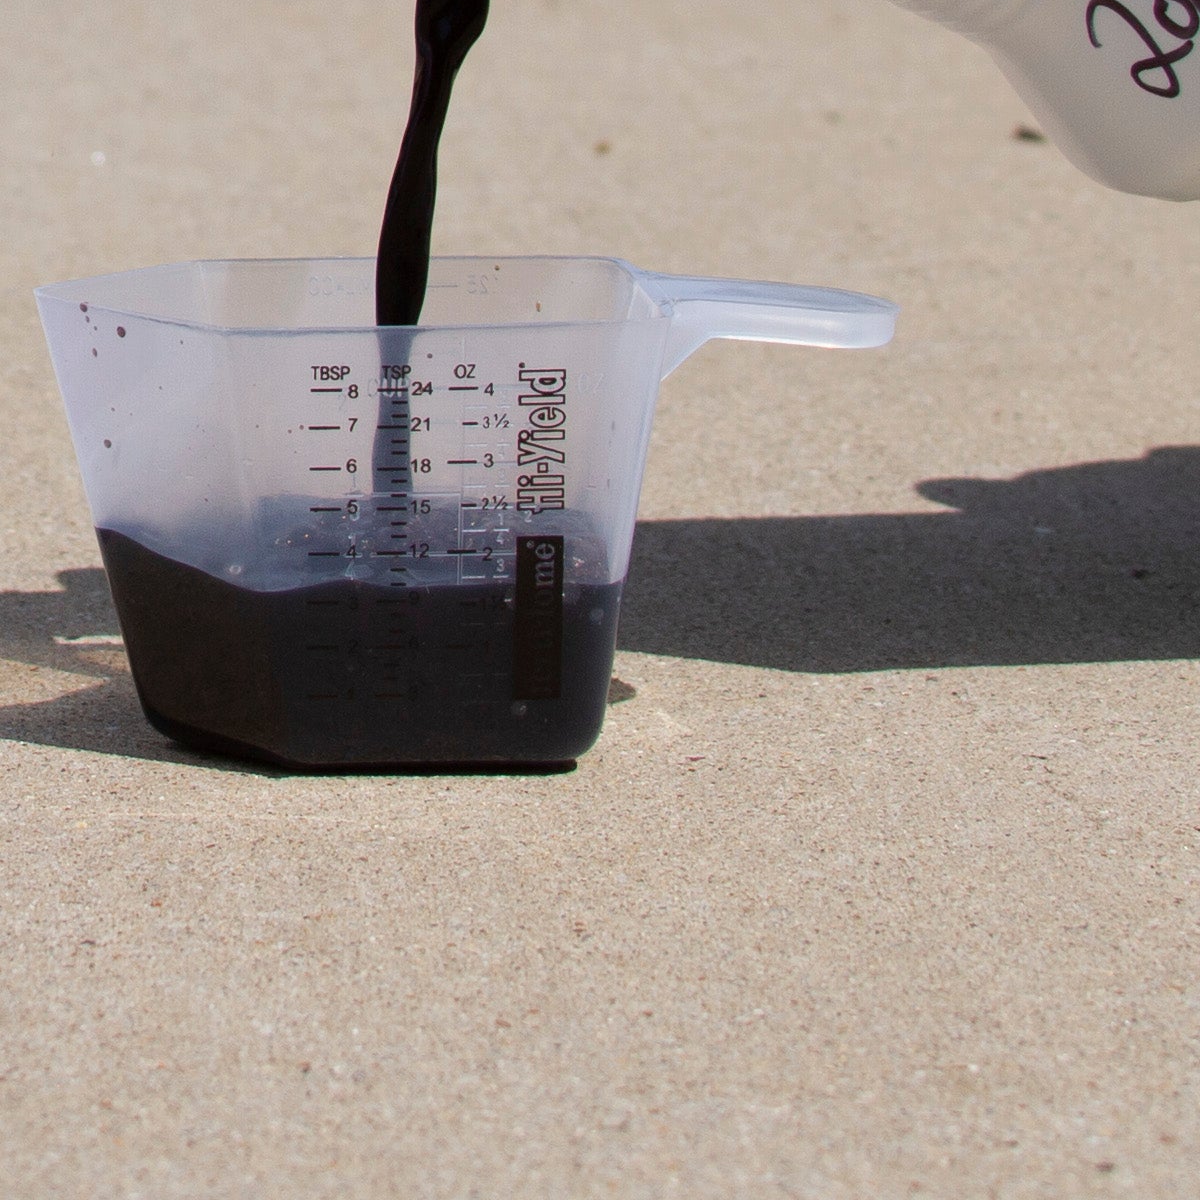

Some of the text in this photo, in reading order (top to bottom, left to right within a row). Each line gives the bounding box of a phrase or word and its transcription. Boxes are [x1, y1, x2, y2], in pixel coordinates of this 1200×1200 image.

[311, 364, 477, 381] TBSP TSP OZ
[346, 381, 495, 399] 8 24 4
[347, 417, 359, 432] 7
[410, 417, 432, 432] 21
[346, 452, 495, 474] 6 18 3
[346, 500, 359, 515] 5
[410, 500, 432, 515] 15
[346, 543, 494, 562] 4 12 2
